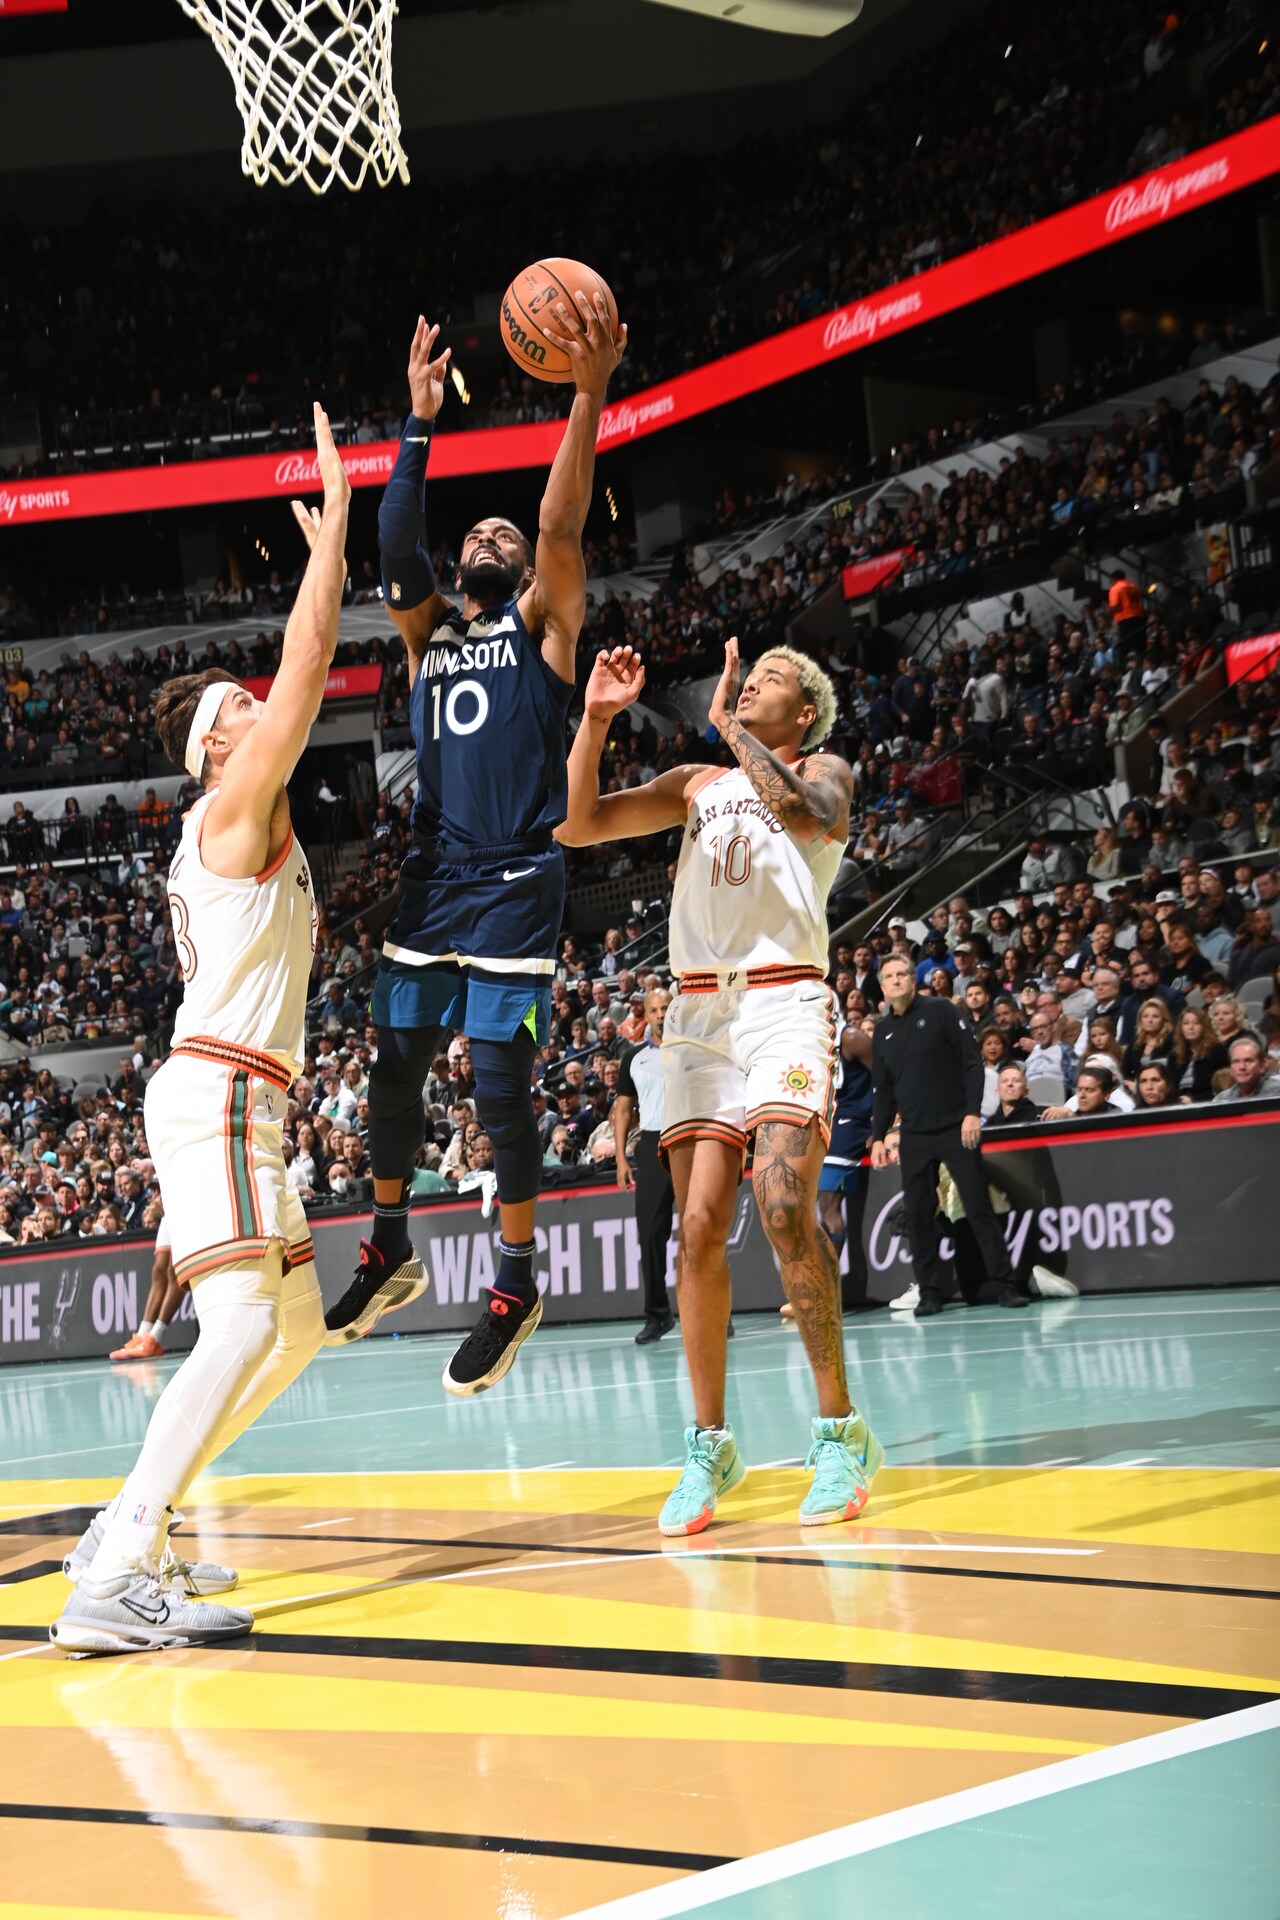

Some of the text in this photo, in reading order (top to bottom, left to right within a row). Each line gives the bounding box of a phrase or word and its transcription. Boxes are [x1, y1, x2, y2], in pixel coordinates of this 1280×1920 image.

[275, 455, 393, 486] Bal SPORTS
[19, 489, 70, 511] SPORTS
[420, 638, 517, 680] MINNSOTA
[432, 680, 488, 740] 10
[690, 805, 717, 842] SAN
[709, 835, 752, 887] 10
[1038, 1197, 1175, 1253] SPORTS
[430, 1222, 582, 1305] WACH
[0, 1282, 41, 1343] HE
[91, 1270, 138, 1335] ON
